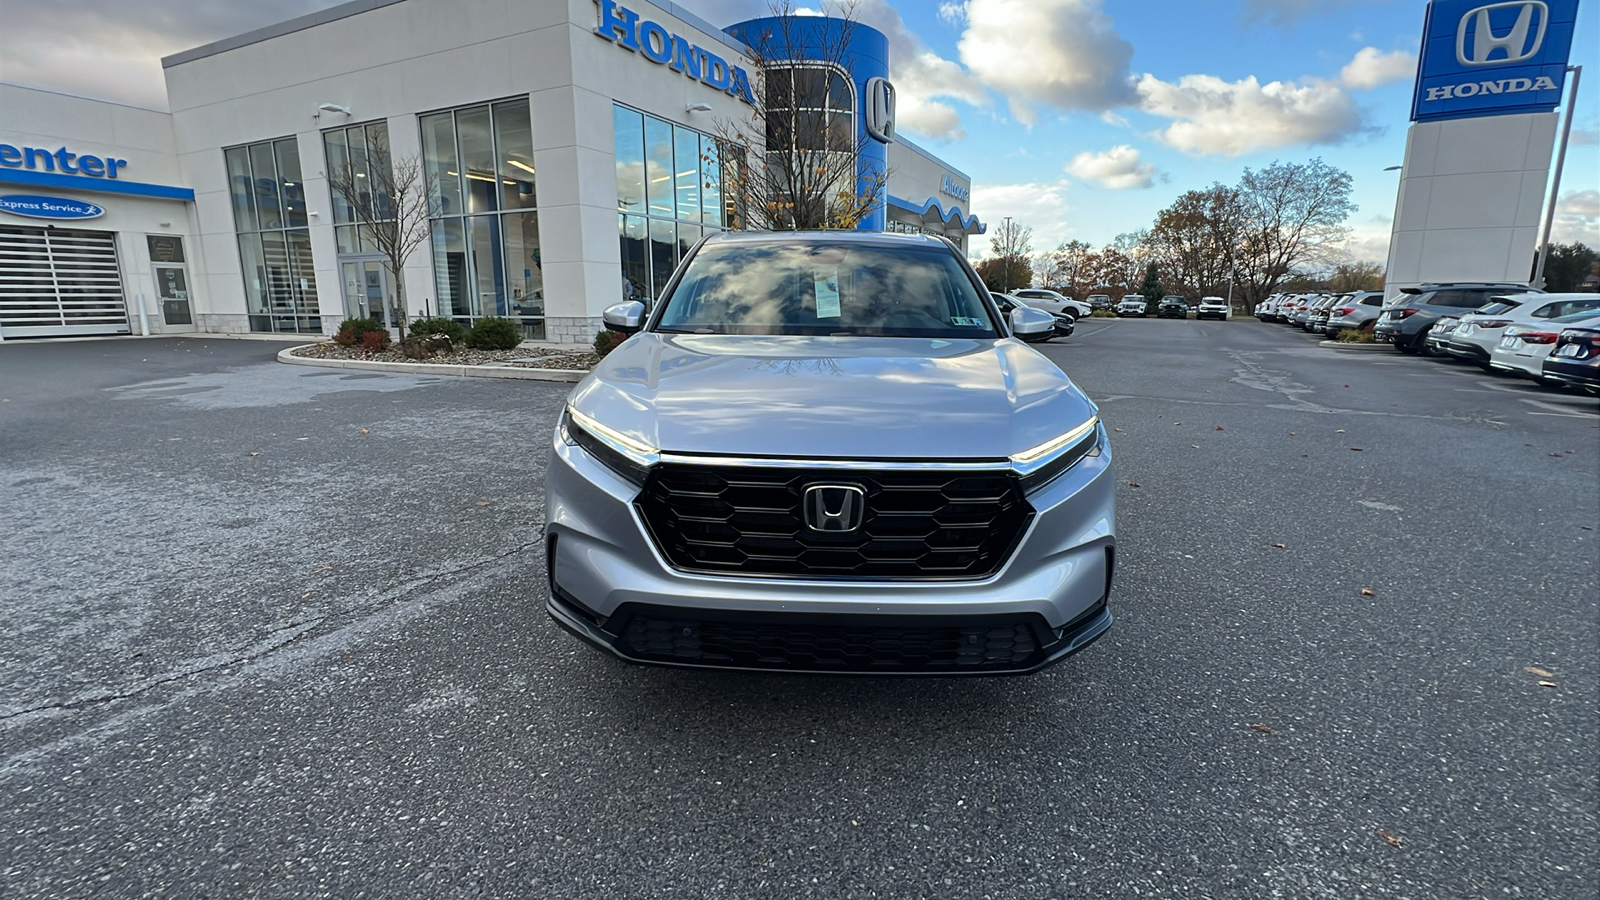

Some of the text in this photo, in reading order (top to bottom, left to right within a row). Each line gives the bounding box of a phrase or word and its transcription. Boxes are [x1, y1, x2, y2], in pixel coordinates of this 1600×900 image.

[594, 0, 756, 103] HONDA
[1425, 76, 1558, 101] HONDA
[0, 143, 127, 178] enter
[42, 202, 82, 213] Service
